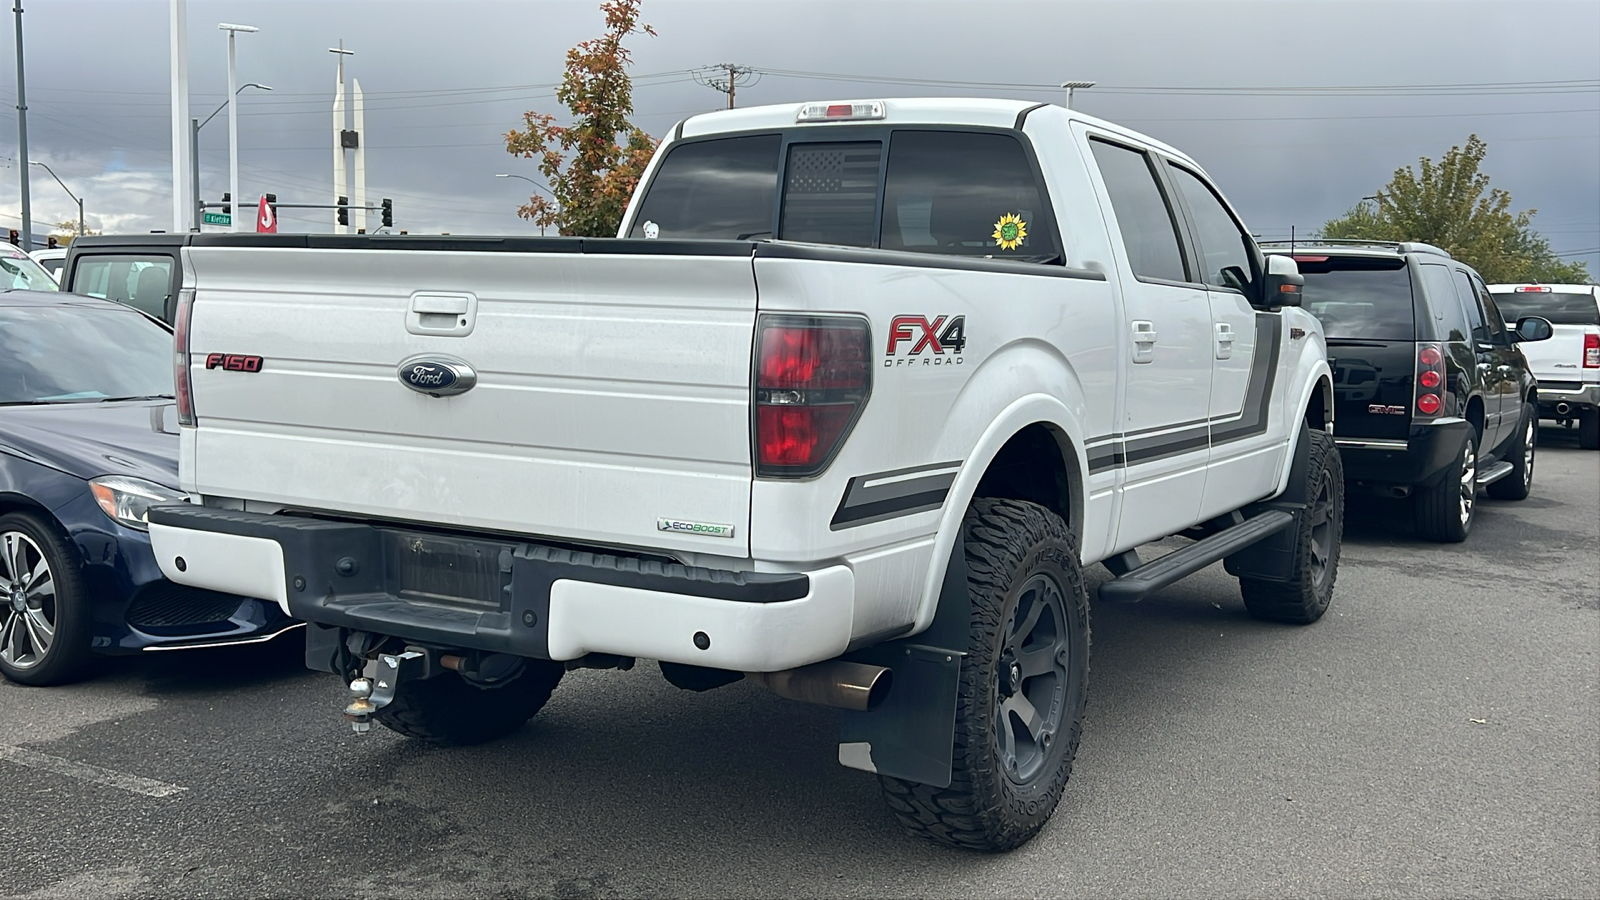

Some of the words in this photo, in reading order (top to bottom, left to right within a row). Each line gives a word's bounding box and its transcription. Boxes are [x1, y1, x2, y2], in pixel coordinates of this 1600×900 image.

[886, 314, 967, 356] FX4
[884, 358, 916, 368] OFF
[922, 357, 964, 366] ROAD
[410, 365, 444, 385] Ford
[1368, 404, 1406, 416] GMC
